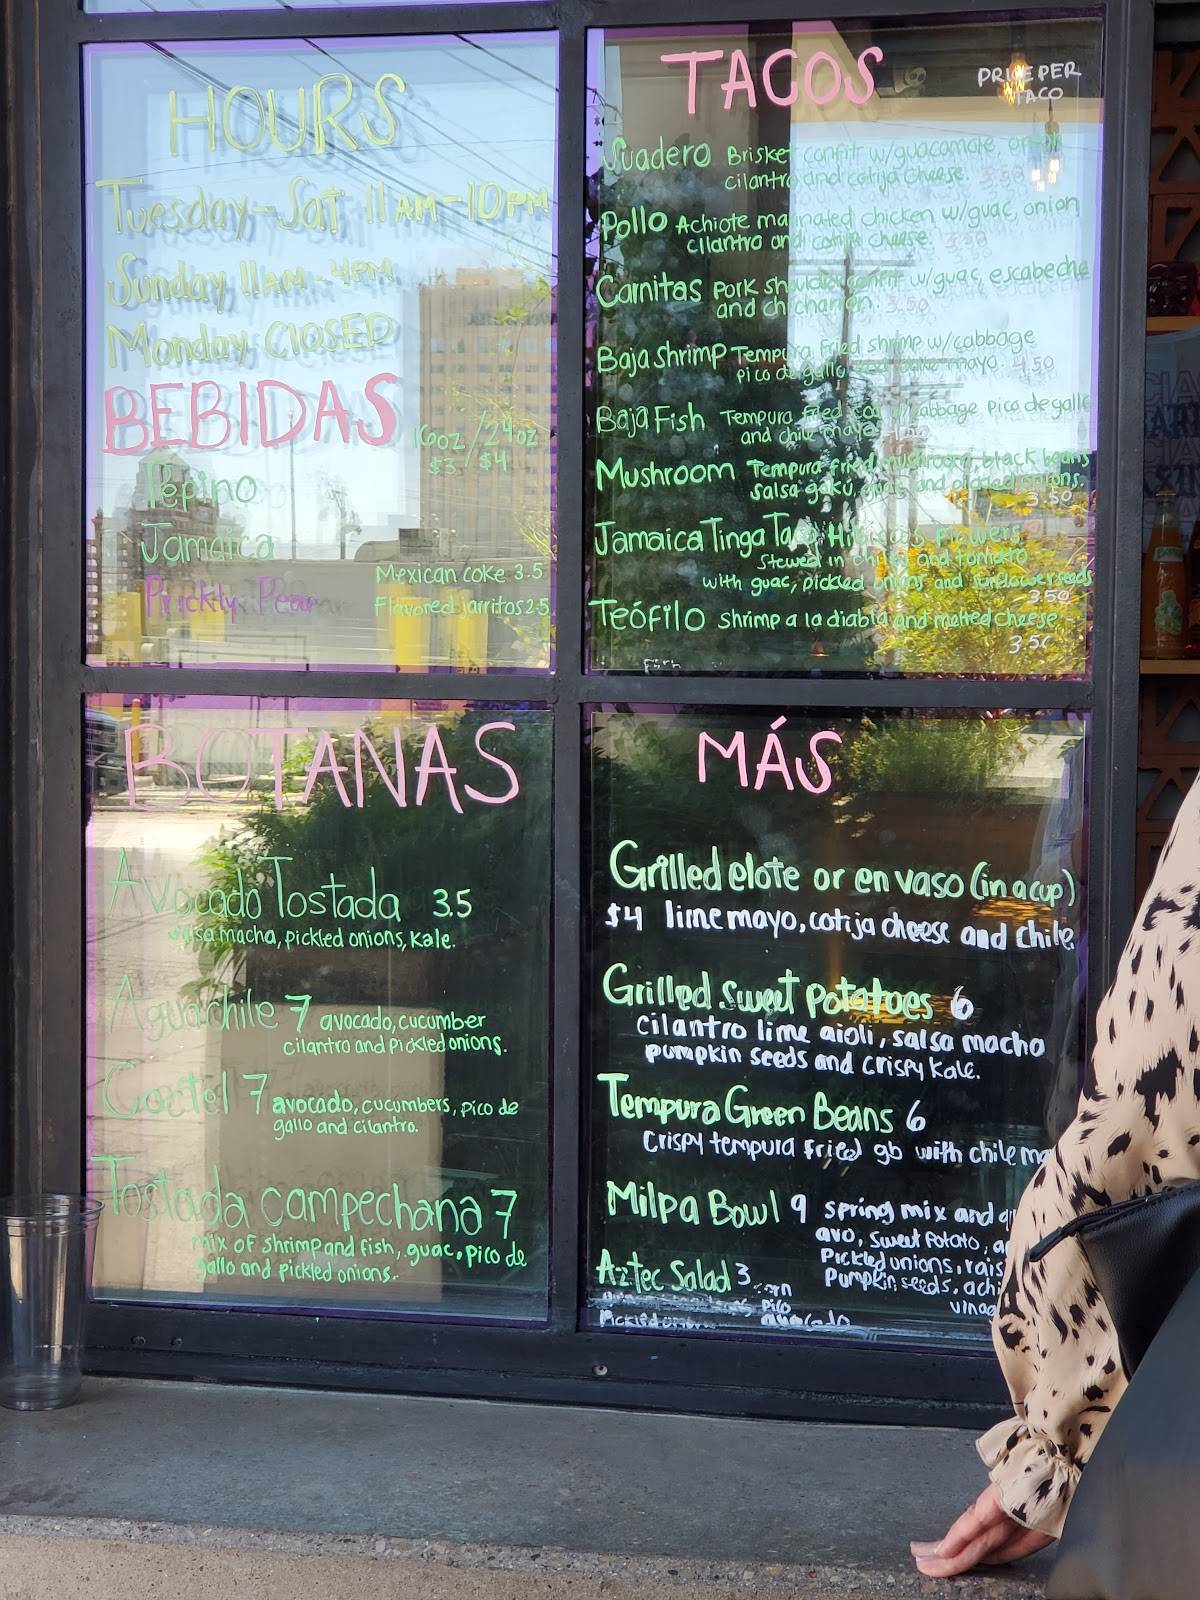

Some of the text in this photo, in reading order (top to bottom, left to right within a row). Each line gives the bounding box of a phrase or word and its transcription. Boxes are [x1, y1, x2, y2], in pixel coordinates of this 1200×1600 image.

[660, 46, 884, 115] TACOS
[1038, 61, 1082, 82] PER
[168, 72, 406, 157] HOURS
[603, 136, 712, 171] Suadero
[724, 171, 798, 192] cilantro
[601, 196, 1080, 241] Pollo Achiote chicken onion
[686, 234, 763, 255] cilantro
[107, 251, 226, 315] Sunday
[595, 255, 1090, 309] Carnitas escabeche
[716, 297, 756, 319] and
[106, 319, 249, 369] Monday
[597, 345, 650, 378] Baja
[736, 364, 847, 386] pico gallo
[101, 372, 398, 456] BEBIDAS
[596, 405, 650, 439] Baja
[654, 401, 706, 434] Fish
[720, 408, 794, 427] Tempura
[740, 427, 772, 445] and
[146, 459, 257, 512] Pepino
[595, 456, 736, 492] Mushroom
[982, 448, 1036, 468] black
[750, 480, 799, 501] salsa
[140, 521, 274, 563] Jamaica
[594, 517, 765, 559] Jamaica Tinga
[375, 562, 458, 585] Mexican
[702, 573, 743, 591] with
[934, 573, 963, 589] and
[144, 573, 320, 624] Prickly Pear
[374, 595, 456, 617] Flavored
[588, 598, 706, 632] Teófilo
[717, 608, 781, 631] shrimp
[785, 612, 798, 628] a
[124, 721, 520, 815] BOTANAS
[698, 715, 843, 794] MÁS
[109, 847, 473, 921] Avocado Tostada 3.5
[610, 839, 722, 892] Grilled
[728, 852, 801, 891] elote
[814, 867, 845, 891] or
[854, 867, 890, 893] en
[894, 868, 965, 899] vaso
[284, 926, 343, 950] pickled
[605, 902, 642, 931] $4
[665, 899, 724, 930] lime
[809, 910, 876, 940] cotija
[881, 911, 950, 945] cheese
[960, 921, 1008, 951] and
[109, 975, 279, 1043] Aguachile
[284, 994, 313, 1034] 7
[398, 1010, 487, 1031] cucumber
[602, 962, 712, 1012] Grilled
[950, 985, 975, 1021] 6
[283, 1036, 351, 1056] cilantro
[355, 1035, 386, 1054] and
[636, 1012, 747, 1040] cilantro
[757, 1018, 811, 1044] lime
[892, 1028, 954, 1053] salsa
[644, 1043, 742, 1066] pumpkin
[749, 1045, 808, 1069] seeds
[814, 1050, 854, 1075] and
[242, 1073, 269, 1115] 7
[460, 1099, 494, 1118] pico
[497, 1097, 520, 1116] de
[596, 1072, 927, 1134] Tempura Green Beans 6
[273, 1118, 313, 1141] gallo
[316, 1117, 348, 1136] and
[709, 1131, 1017, 1167] tempura fried with chile
[89, 1155, 250, 1229] Tostada
[490, 1188, 518, 1239] 7
[606, 1180, 700, 1226] Milpa
[707, 1188, 780, 1229] Bowl
[790, 1193, 807, 1224] 9
[824, 1197, 895, 1226] spring
[900, 1199, 947, 1223] mix
[954, 1201, 994, 1227] and
[191, 1232, 528, 1268] mix shrimp and pico de
[195, 1256, 236, 1281] gallo
[240, 1258, 271, 1280] and
[279, 1259, 332, 1283] pickled
[595, 1248, 665, 1294] Aztec
[670, 1258, 732, 1293] Salad
